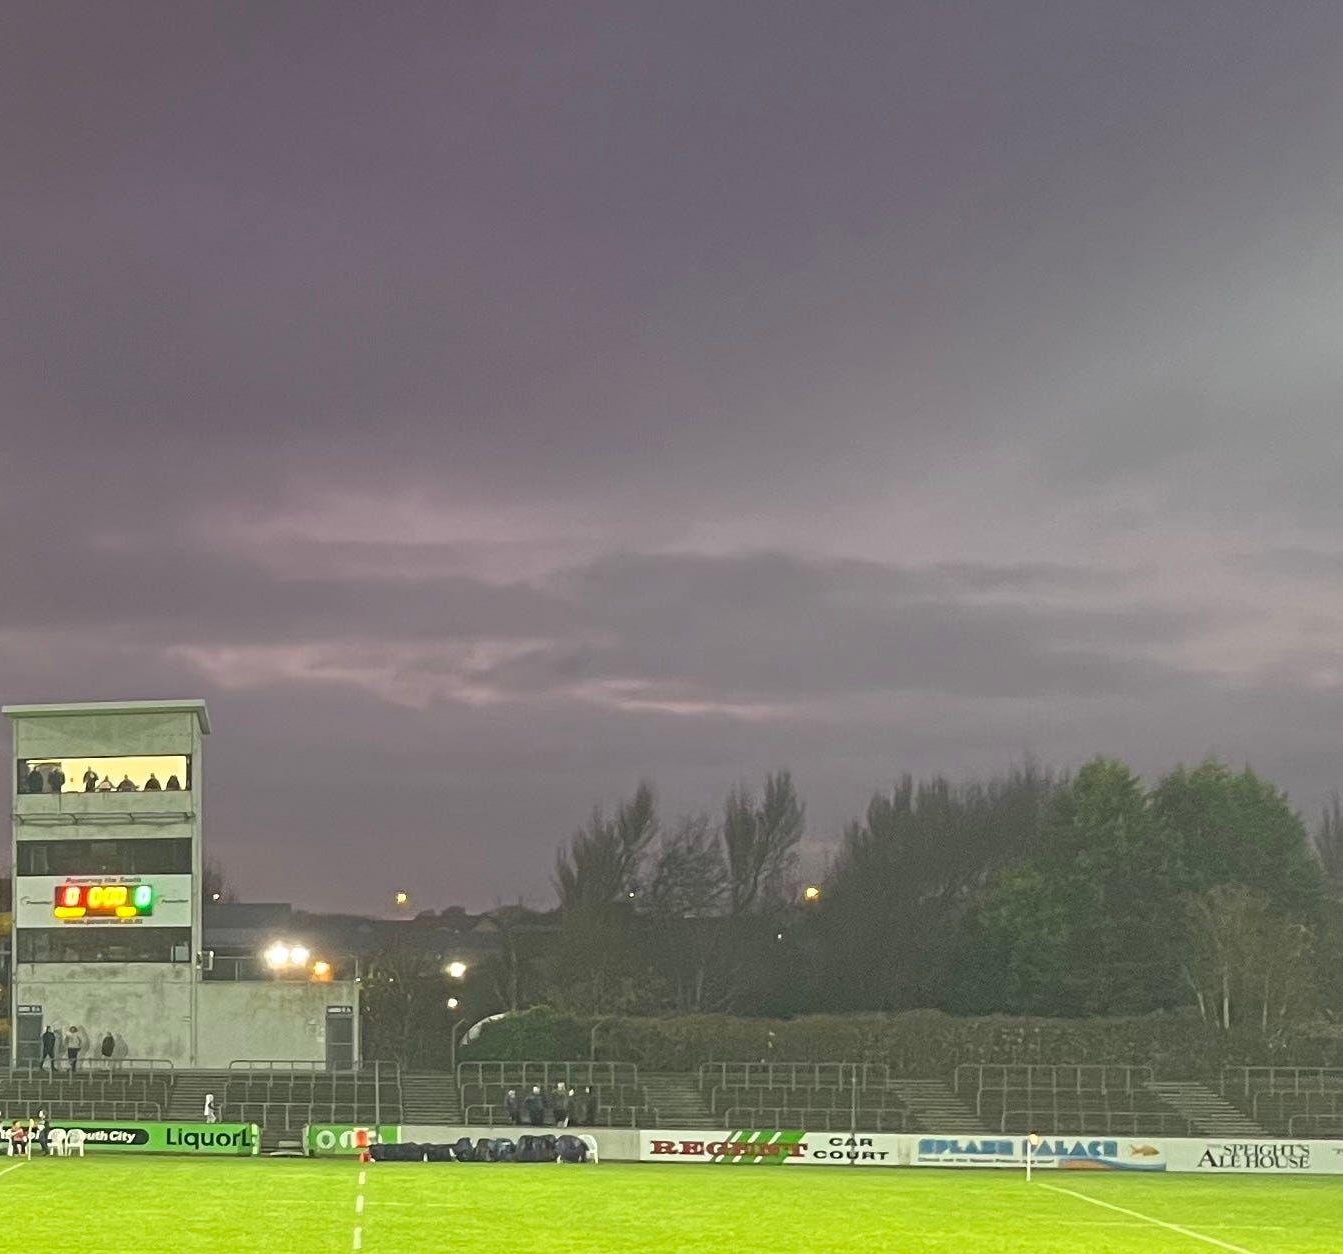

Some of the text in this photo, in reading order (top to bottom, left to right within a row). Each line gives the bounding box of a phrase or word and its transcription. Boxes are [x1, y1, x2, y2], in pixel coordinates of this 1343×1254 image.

[650, 1139, 889, 1160] REGENT COURT
[828, 1137, 873, 1147] CAR
[1197, 1148, 1311, 1168] ALE HOUSE
